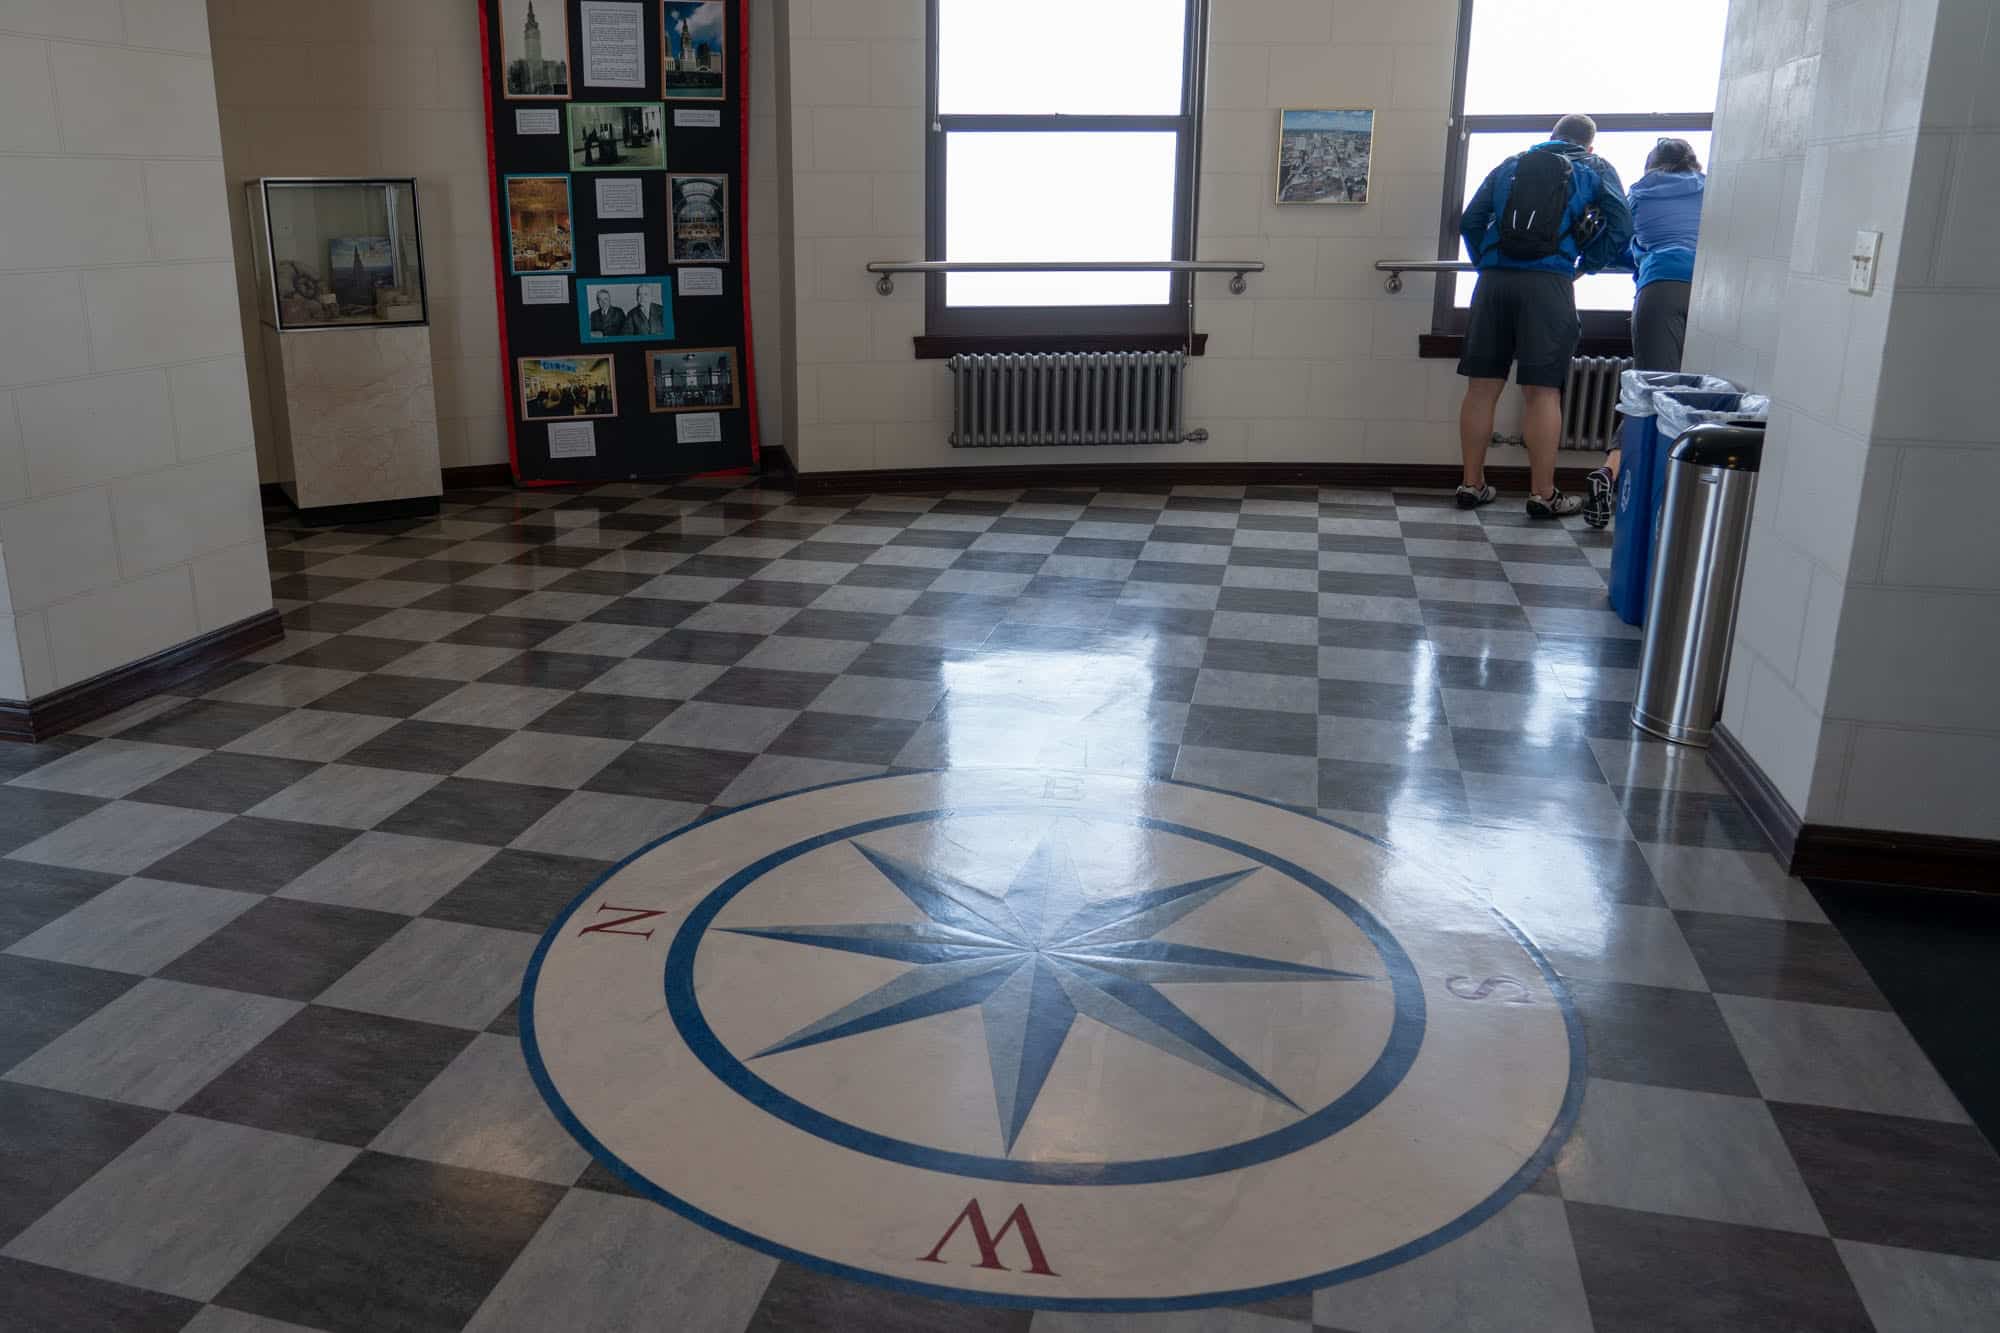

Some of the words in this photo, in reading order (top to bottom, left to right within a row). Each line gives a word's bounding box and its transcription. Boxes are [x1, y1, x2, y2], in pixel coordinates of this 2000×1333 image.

[578, 902, 667, 941] N
[1446, 975, 1536, 1003] S
[916, 1198, 1062, 1277] W
